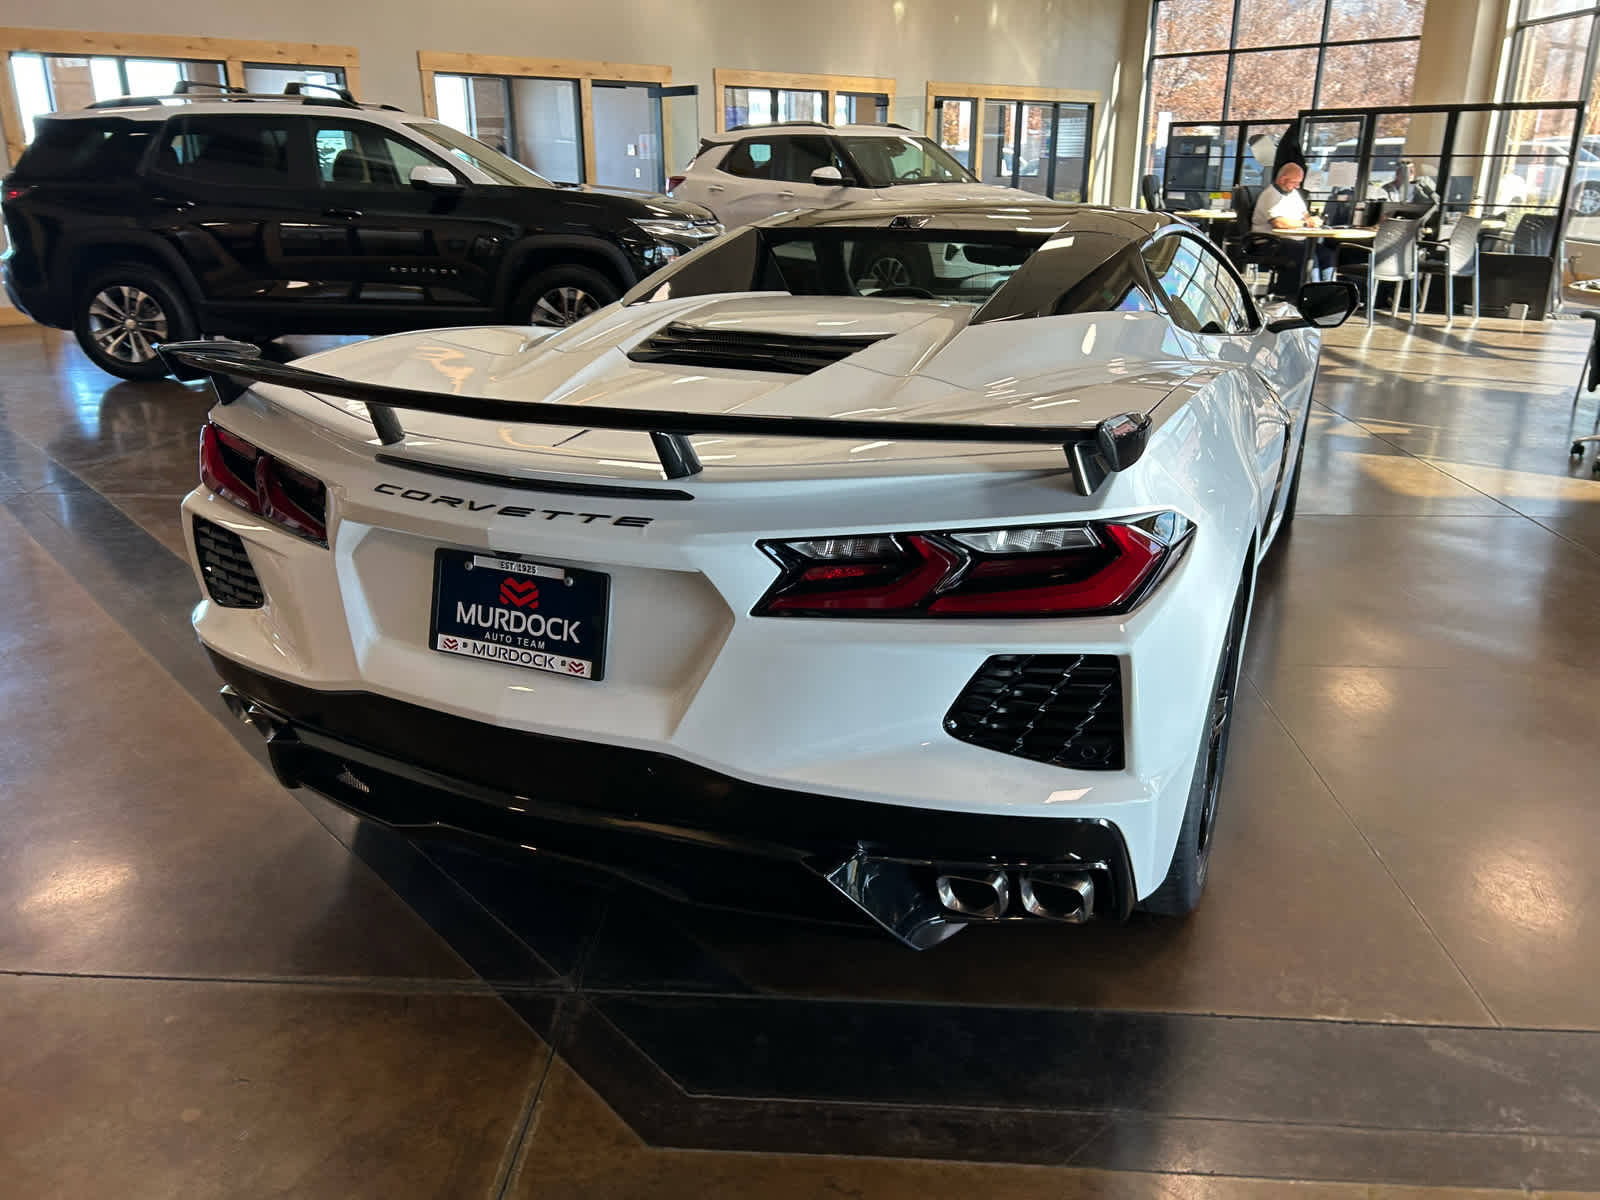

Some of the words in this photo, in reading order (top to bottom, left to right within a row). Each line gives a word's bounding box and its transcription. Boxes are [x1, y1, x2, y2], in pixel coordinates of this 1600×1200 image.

[373, 483, 655, 528] CORVETTE
[456, 601, 581, 644] MURDOCK
[472, 642, 556, 669] MURDOCK
[484, 631, 512, 644] AUTO
[517, 638, 546, 650] TEAM
